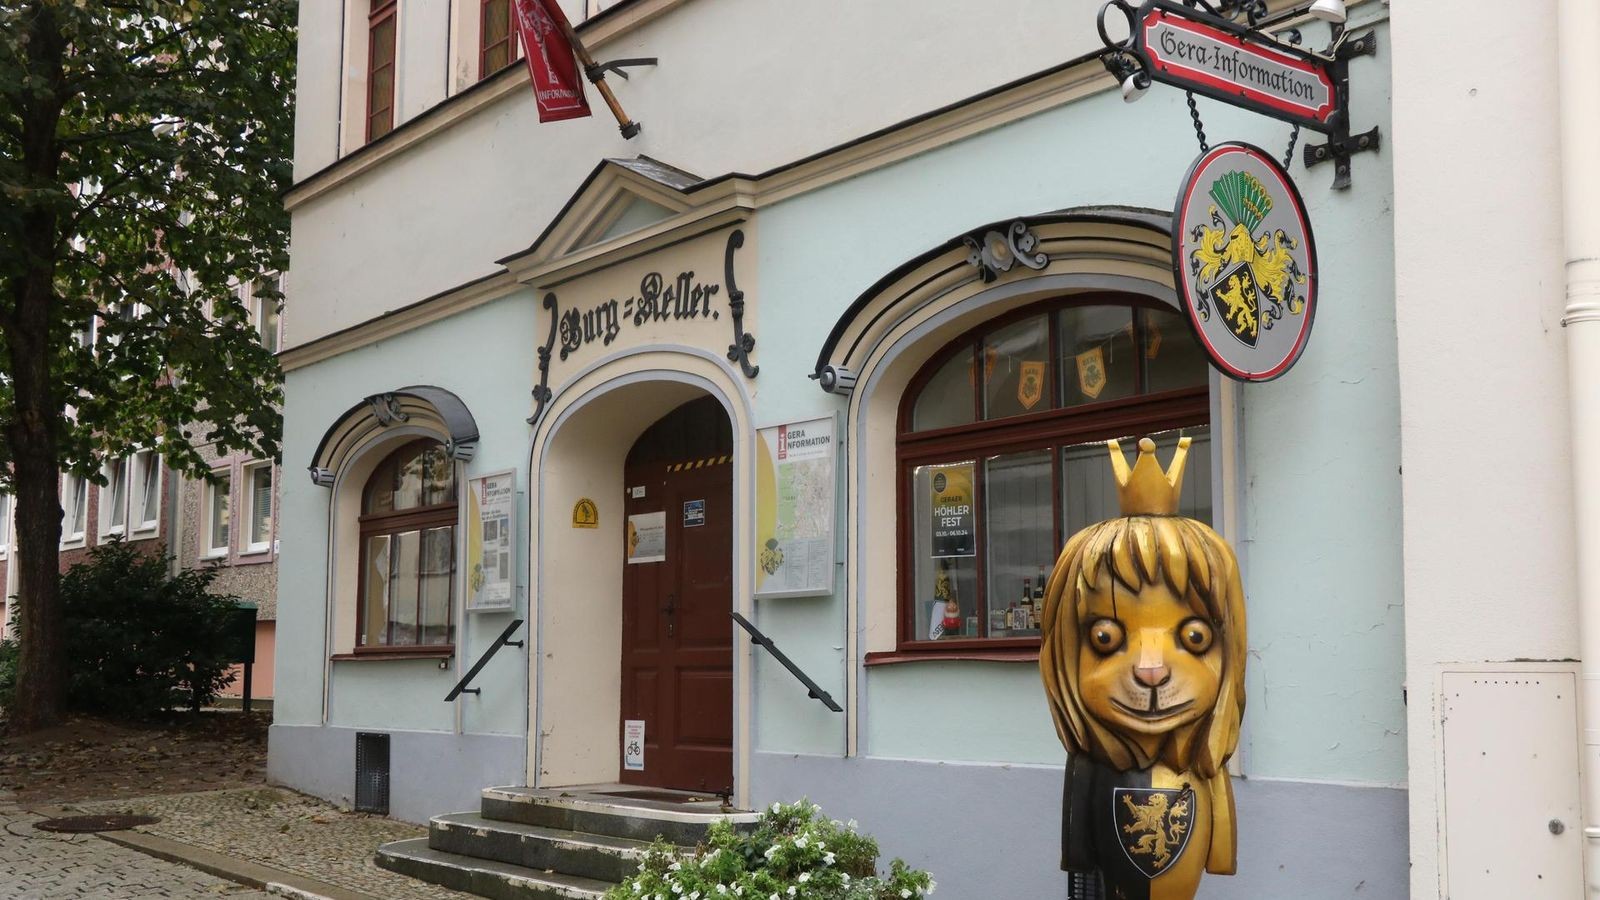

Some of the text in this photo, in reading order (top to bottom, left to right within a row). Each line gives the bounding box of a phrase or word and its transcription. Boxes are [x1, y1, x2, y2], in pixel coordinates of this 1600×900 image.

[1160, 27, 1315, 101] Gera-Information
[787, 430, 806, 440] GERA
[934, 504, 970, 517] HÖHLER
[941, 516, 962, 528] FEST
